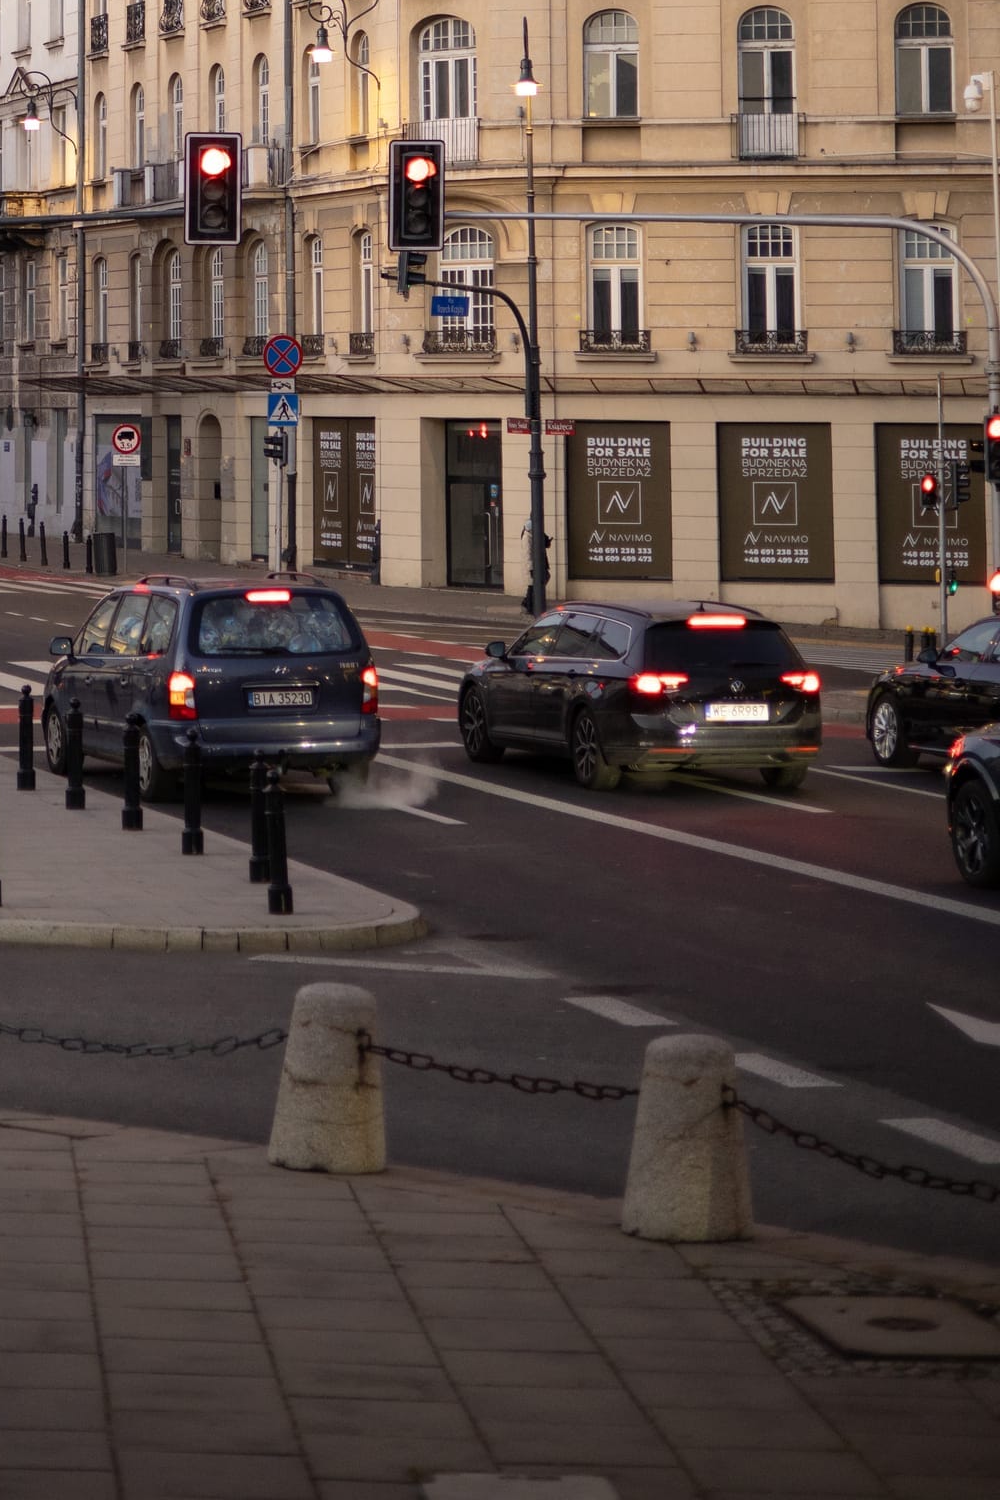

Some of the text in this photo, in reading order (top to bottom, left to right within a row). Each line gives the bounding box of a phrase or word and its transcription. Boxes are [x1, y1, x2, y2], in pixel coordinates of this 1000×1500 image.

[320, 431, 341, 440] BUILDING
[356, 432, 375, 441] BUILDIN
[320, 441, 341, 449] FOR SALE
[356, 442, 375, 451] FOR SAL
[587, 437, 651, 447] BUILDING
[742, 438, 807, 447] BUILDING
[901, 439, 967, 449] BUILDING
[587, 447, 651, 457] FOR SALE
[742, 448, 807, 457] FOR SALE
[901, 449, 928, 459] FOR
[587, 458, 651, 467] BUDYNEK NA
[742, 459, 807, 467] BUDYNEK NA
[901, 460, 950, 469] BUDYNK
[587, 467, 651, 477] SPRZEDAŻ
[742, 467, 808, 477] SPRZEDAŻ
[609, 534, 652, 542] NAVIMO
[764, 535, 809, 543] NAVIMO
[923, 538, 969, 546] NAIMO
[589, 547, 652, 555] +48 691 238 333
[744, 548, 809, 556] +48 691 238 333
[589, 555, 652, 563] +48 609 499 473
[744, 556, 809, 564] +48 609 499 473
[902, 559, 969, 567] +48 609 49 473
[253, 692, 311, 706] BIA 35230
[713, 705, 727, 717] WE
